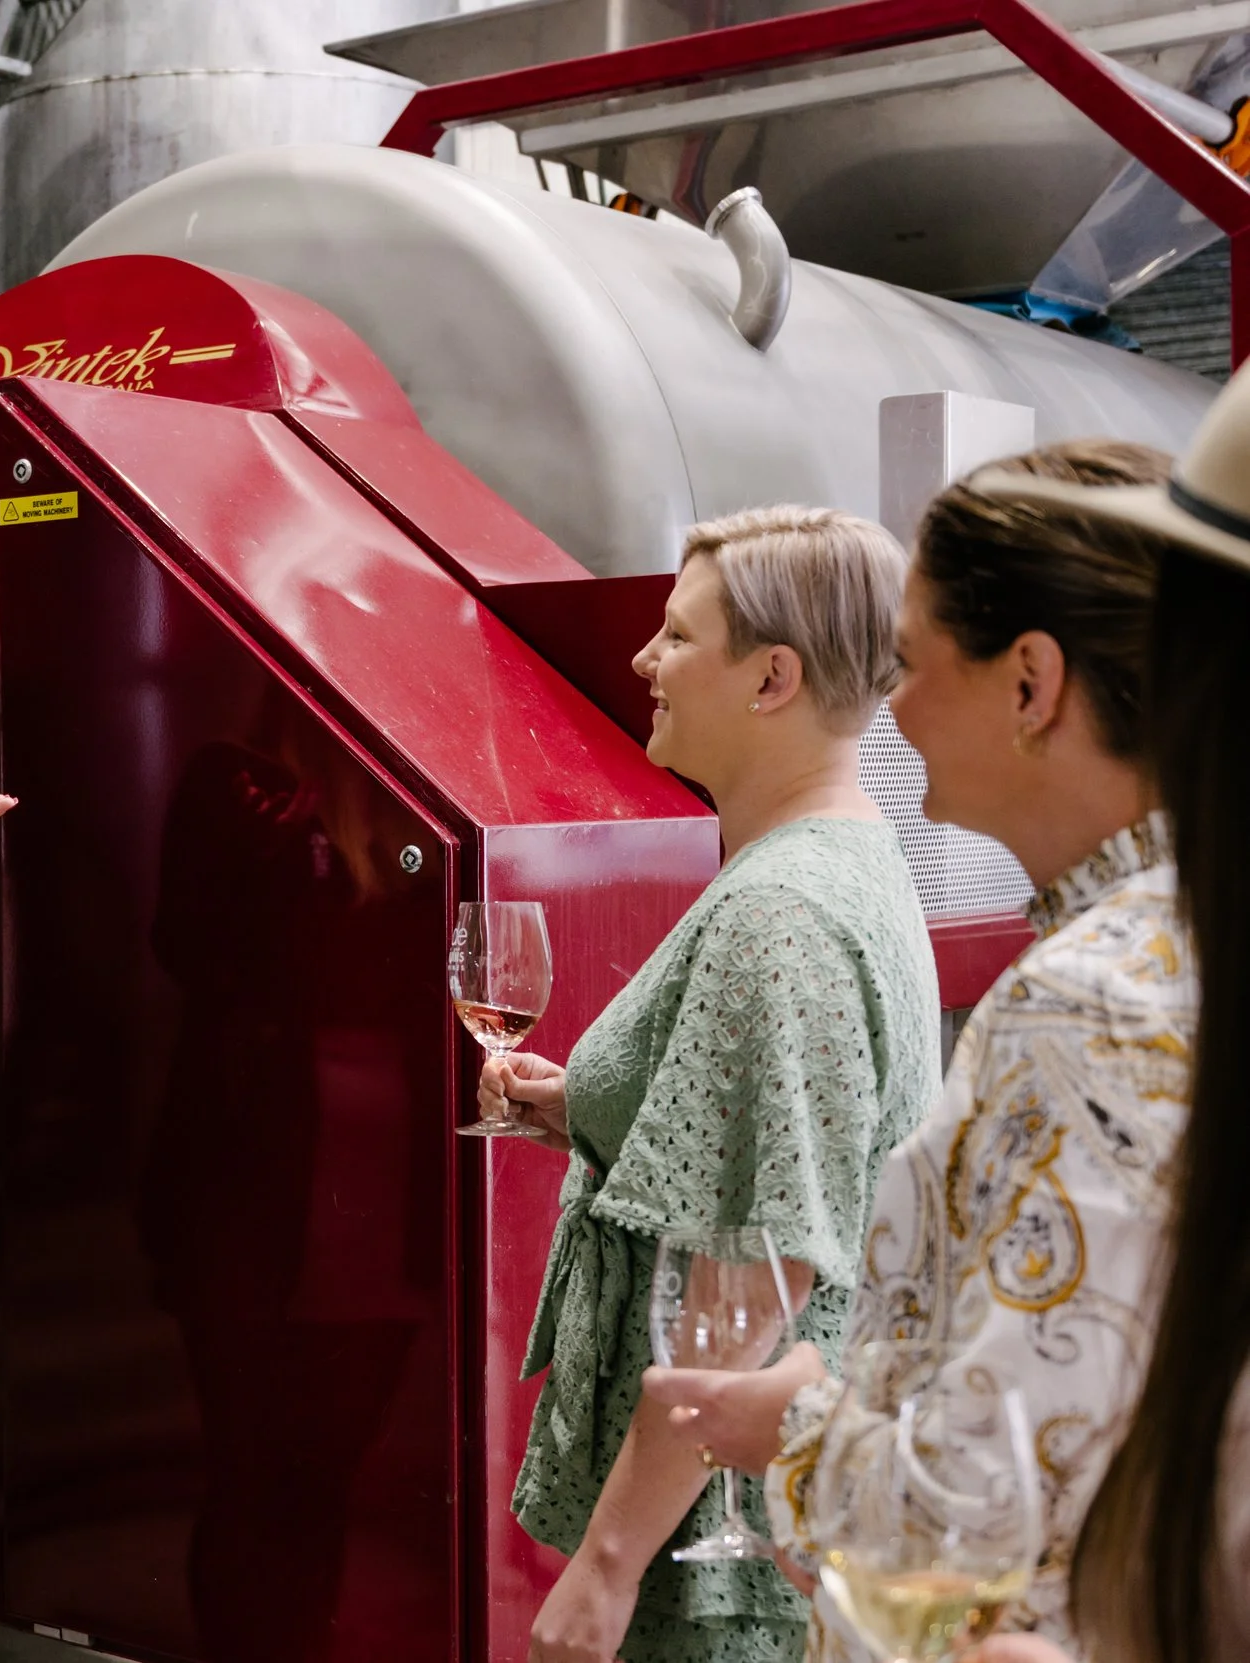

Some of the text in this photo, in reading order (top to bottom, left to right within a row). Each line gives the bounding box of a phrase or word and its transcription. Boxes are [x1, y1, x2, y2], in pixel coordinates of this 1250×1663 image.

[32, 498, 63, 508] BEWARE OF
[22, 506, 74, 518] MOVING MACHINERY
